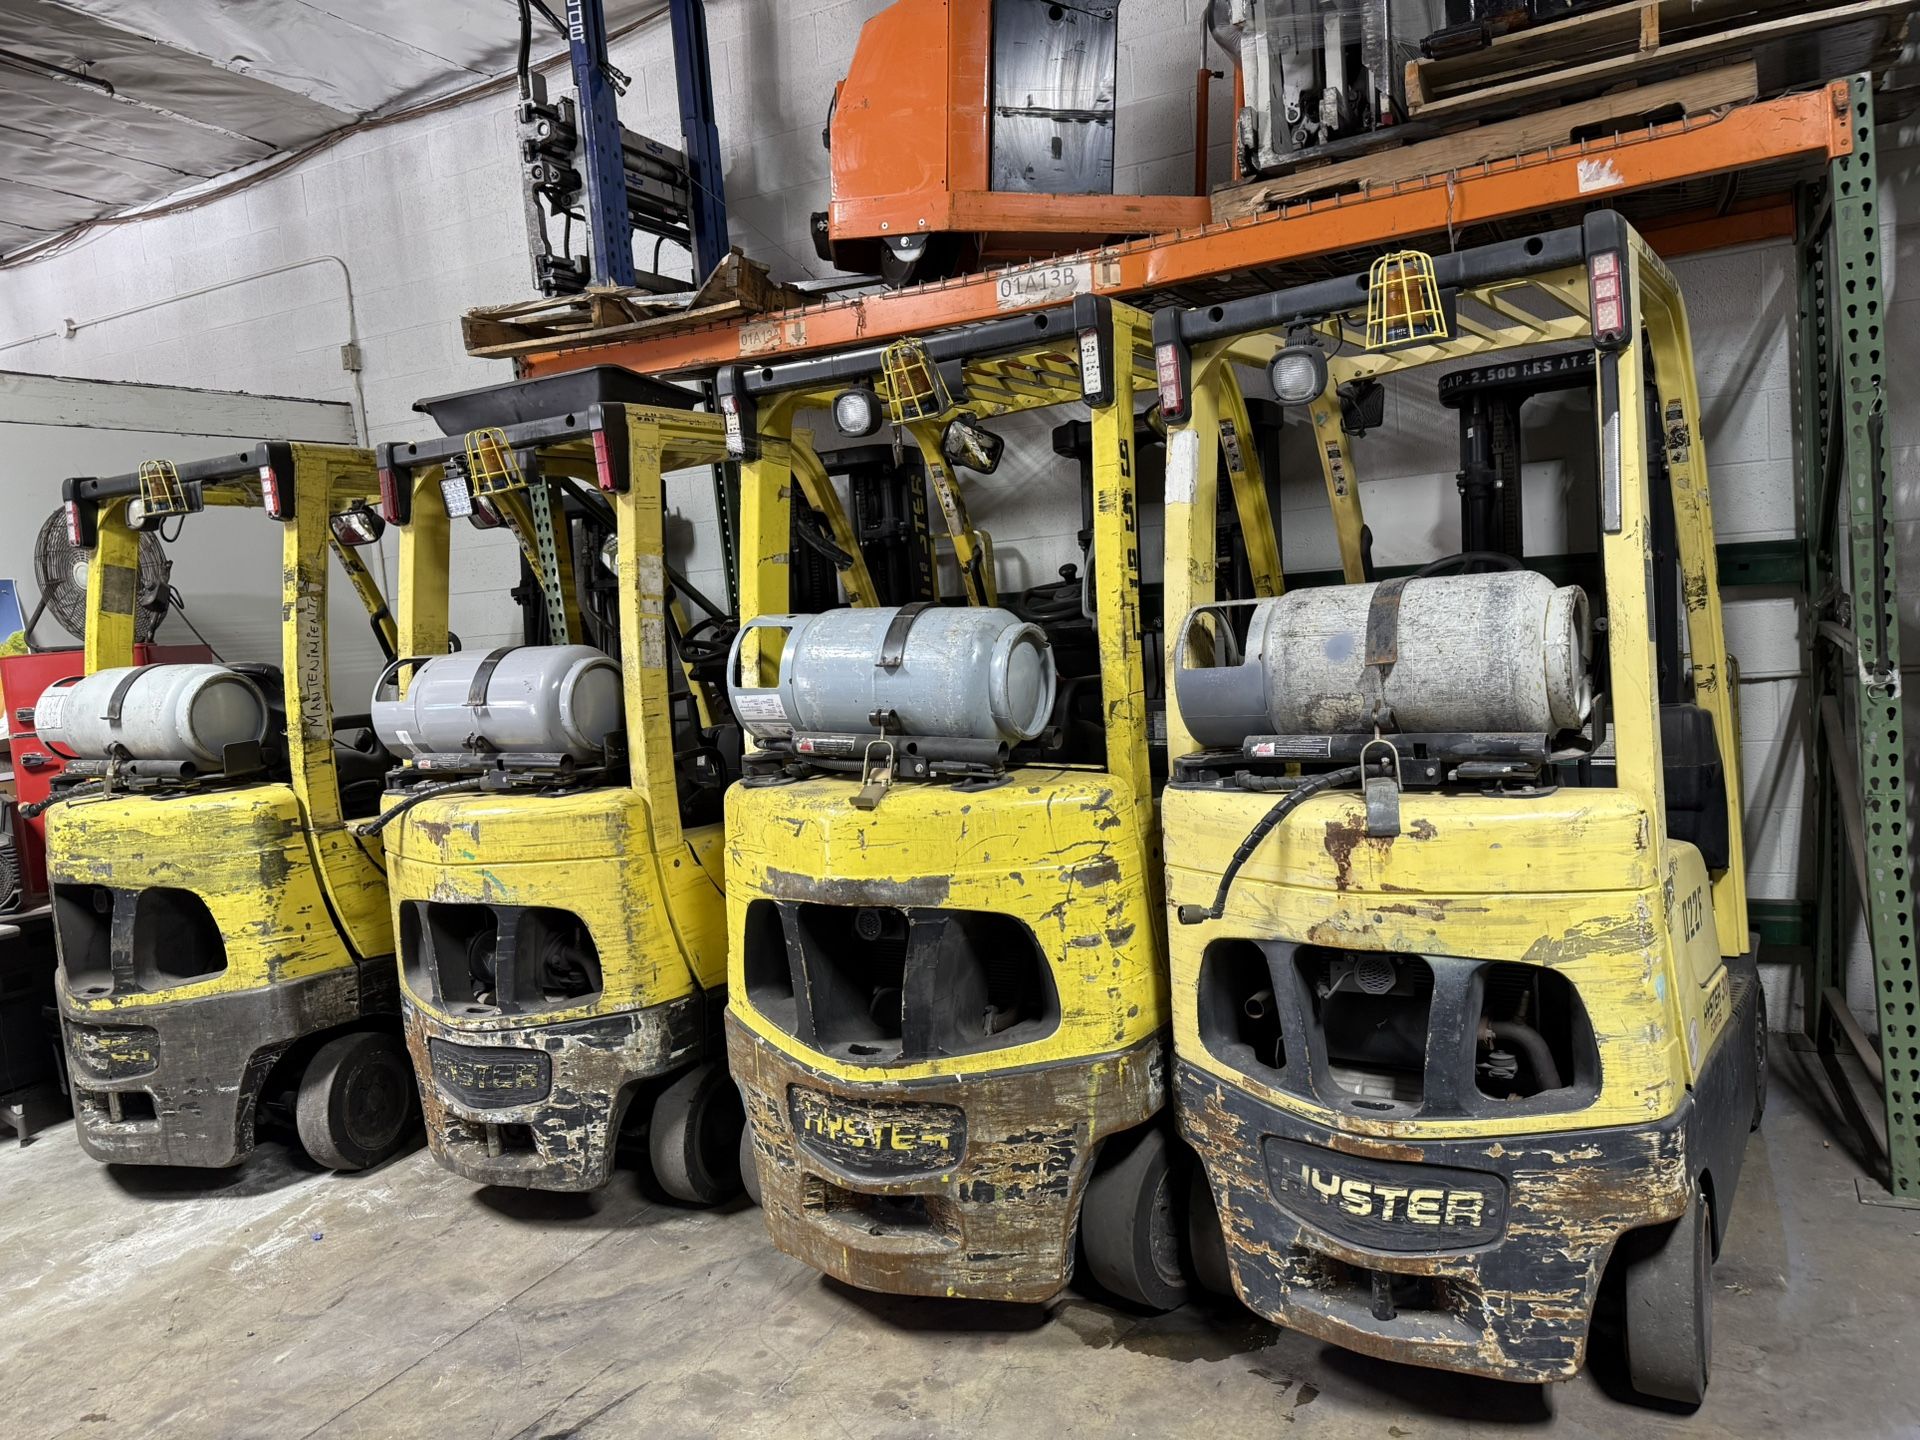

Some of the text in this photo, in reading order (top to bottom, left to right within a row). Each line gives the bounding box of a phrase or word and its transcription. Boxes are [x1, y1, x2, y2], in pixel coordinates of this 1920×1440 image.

[1000, 267, 1075, 298] 01A13B
[1560, 352, 1606, 370] AT.2
[1281, 1157, 1485, 1228] HYSTER
